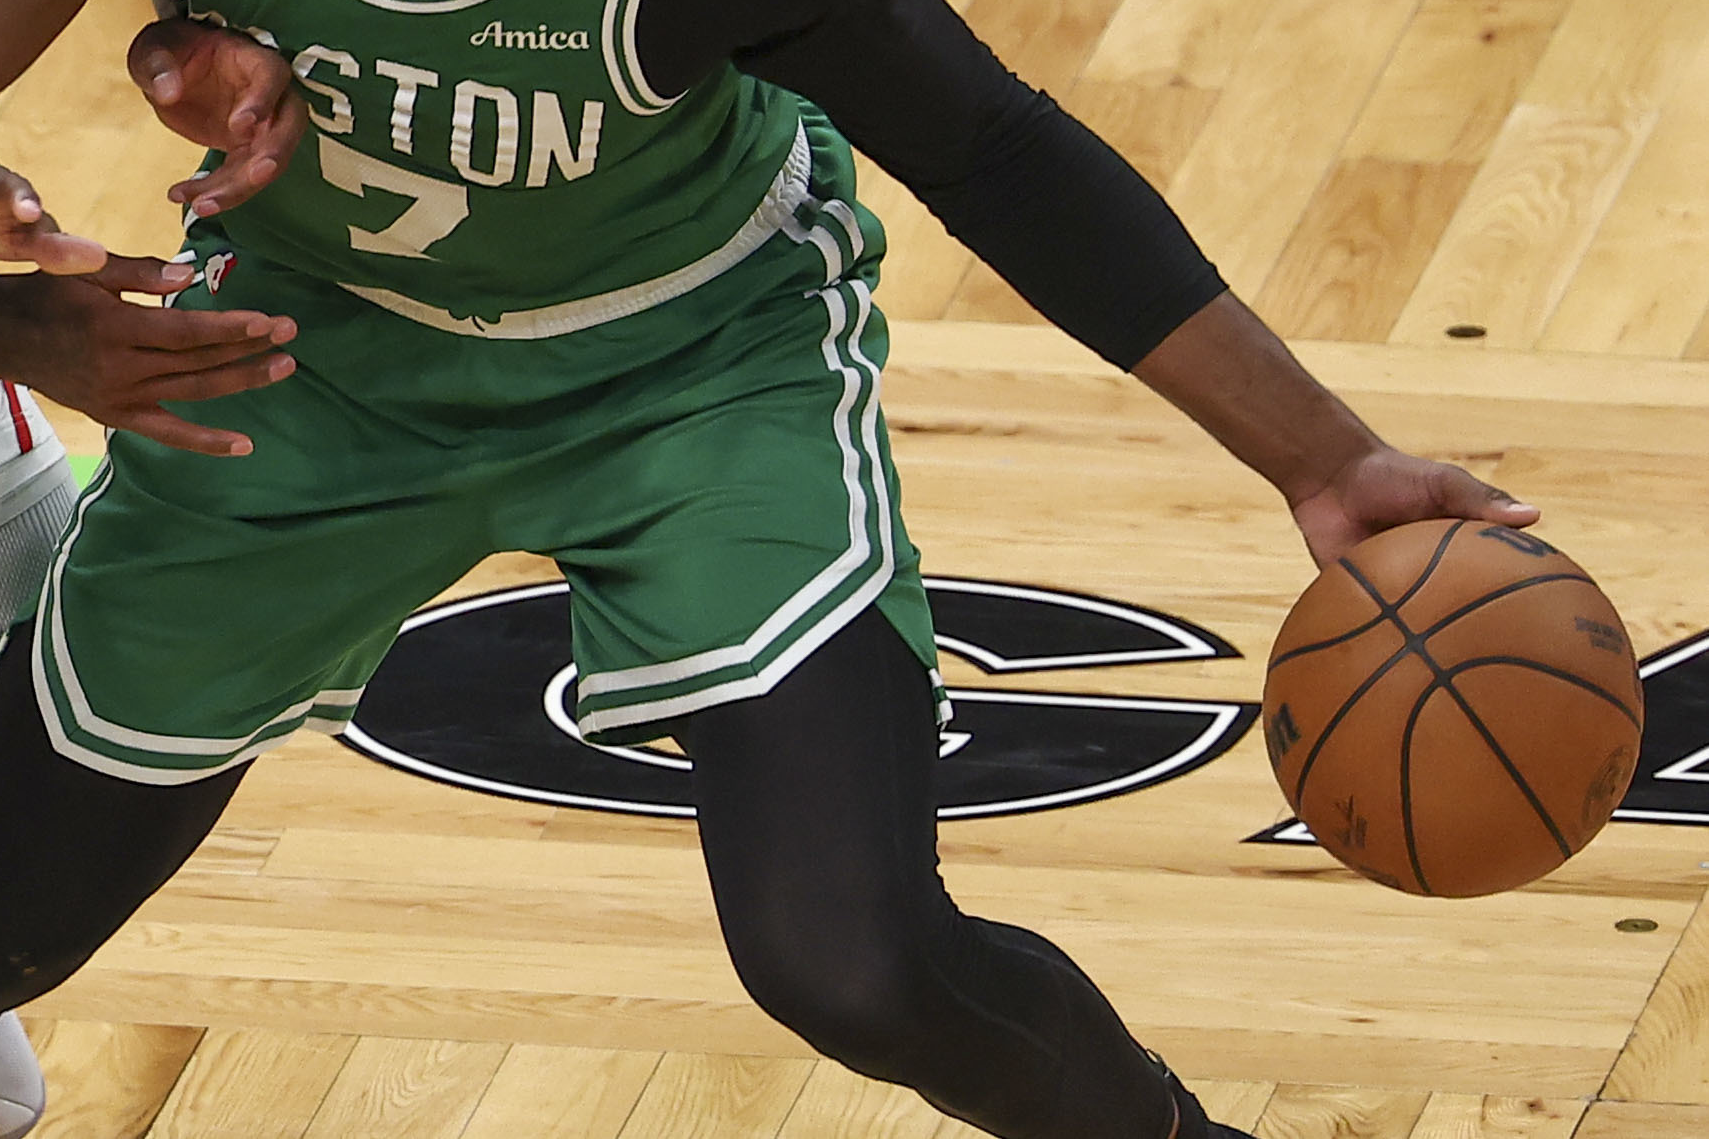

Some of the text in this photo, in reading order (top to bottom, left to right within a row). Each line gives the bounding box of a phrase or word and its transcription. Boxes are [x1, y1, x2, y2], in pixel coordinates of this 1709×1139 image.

[470, 21, 590, 50] Amica
[188, 11, 604, 188] STON
[317, 134, 471, 261] 7
